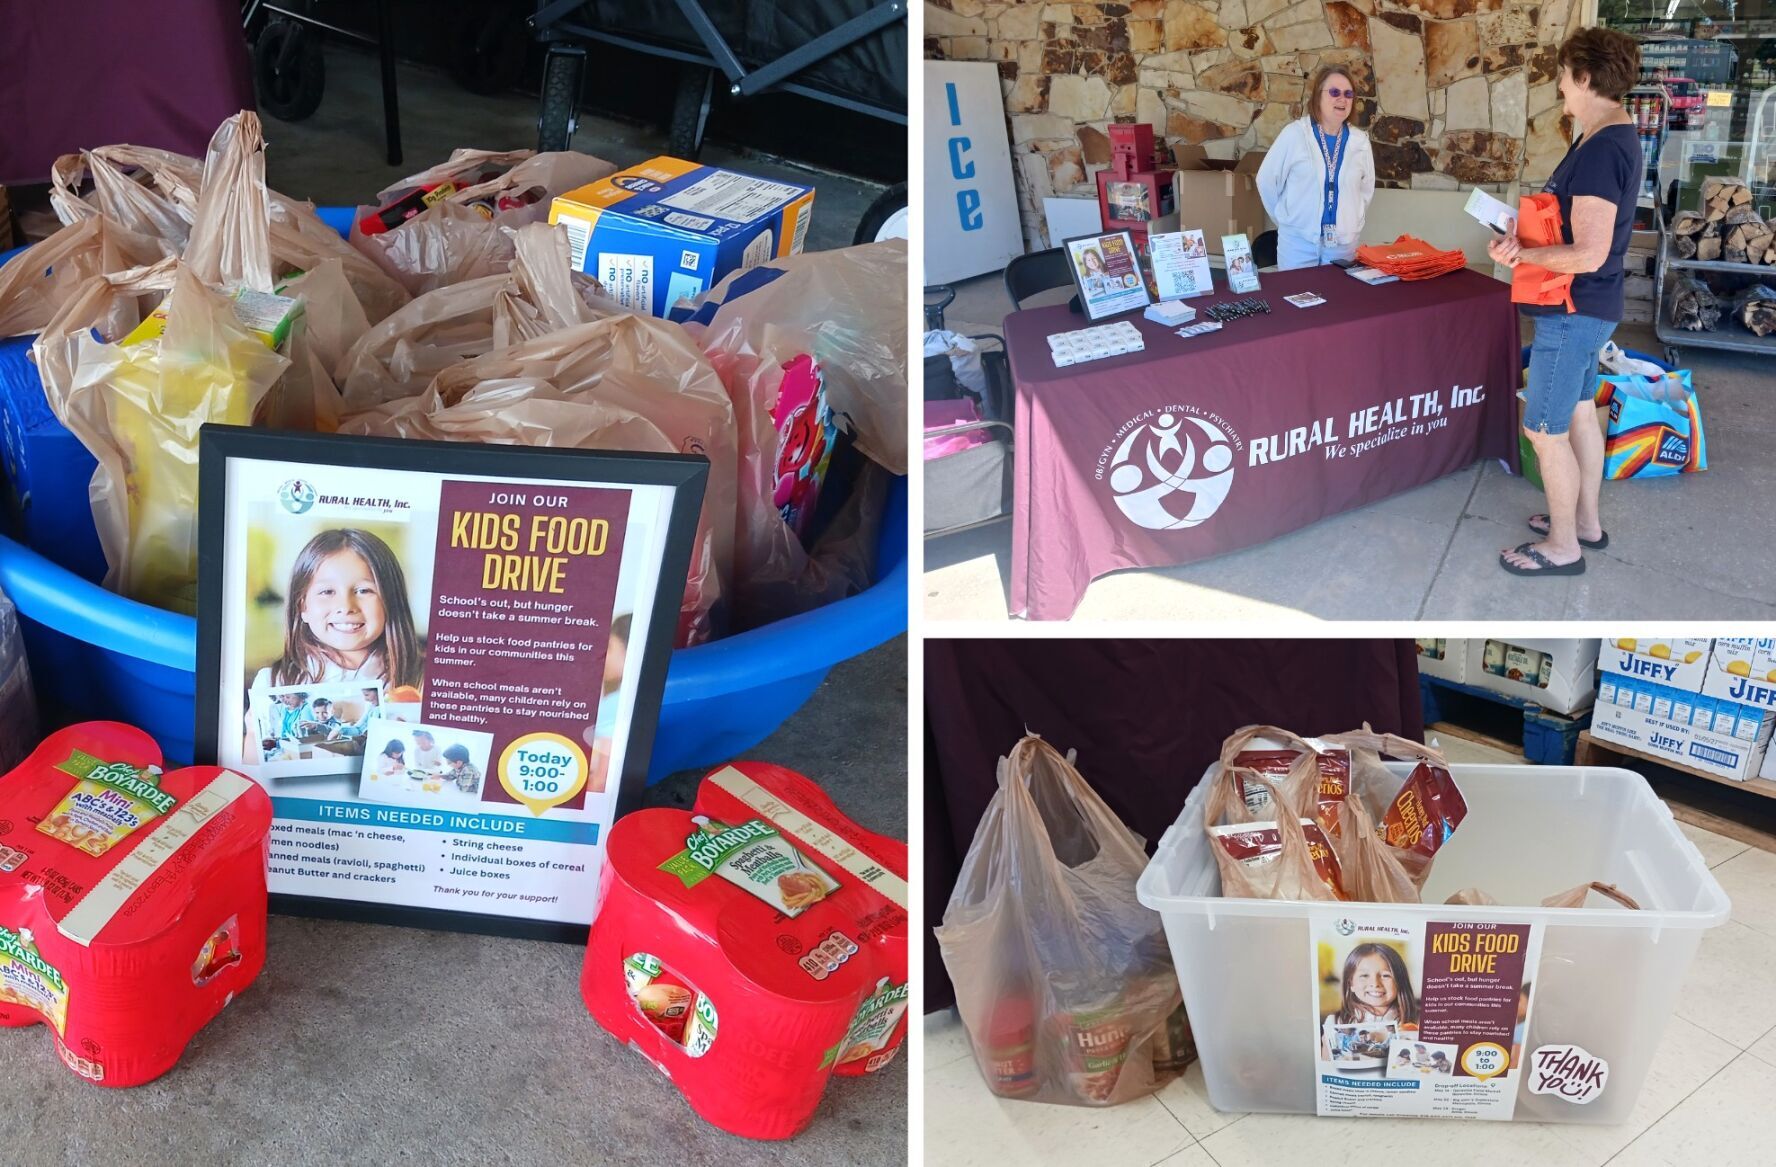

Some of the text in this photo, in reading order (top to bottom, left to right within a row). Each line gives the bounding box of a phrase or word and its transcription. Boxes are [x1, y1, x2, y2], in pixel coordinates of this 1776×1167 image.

[945, 82, 984, 232] Ice
[609, 267, 616, 282] no
[626, 268, 633, 283] no
[641, 270, 649, 284] no
[1248, 384, 1486, 467] RURAL HEALTH, Inc.
[1094, 404, 1244, 480] OB/GYN MEDICAL DENTAL PSYCHIATRY
[1324, 416, 1448, 460] We specialize in you
[1660, 451, 1686, 462] ALDI
[318, 495, 410, 508] RURAL HEALTH, Inc.
[488, 492, 569, 508] JOIN OUR
[450, 511, 609, 556] KIDS FOOD
[482, 554, 569, 594] DRIVE
[439, 595, 573, 613] School's out, but hunger
[438, 609, 479, 619] doesn't
[482, 612, 506, 621] take
[518, 615, 562, 624] summer
[564, 616, 599, 627] break.
[436, 633, 460, 644] Help
[476, 635, 505, 645] stock
[507, 637, 531, 647] food
[533, 639, 575, 650] pantries
[578, 642, 593, 651] for
[434, 645, 574, 662] kids in our communities this
[434, 657, 476, 666] summer.
[432, 678, 562, 696] When school meals aren't
[430, 690, 586, 709] available, many children rely on
[428, 712, 488, 725] and healthy.
[430, 701, 458, 710] these
[460, 703, 500, 714] pantries
[515, 708, 540, 718] stay
[539, 709, 590, 720] nourished
[1645, 718, 1657, 726] BEST
[1666, 723, 1680, 732] USED
[517, 750, 572, 768] Today
[109, 762, 140, 777] Chef
[519, 765, 565, 778] 9:00-
[86, 765, 177, 814] BOYARDEE
[522, 780, 559, 792] 1:00
[75, 802, 92, 812] with
[99, 790, 134, 810] Mini
[71, 793, 106, 809] ABC's
[114, 808, 139, 828] 123's
[319, 805, 526, 833] ITEMS NEEDED INCLUDE
[1396, 790, 1423, 845] Cheerios
[270, 824, 293, 833] oxed
[295, 826, 325, 836] meals
[327, 828, 352, 838] (mac
[367, 832, 406, 843] cheese,
[686, 830, 711, 850] Chef
[271, 839, 340, 852] men noodles)
[452, 839, 524, 852] String cheese
[690, 820, 775, 870] BOYARDEE
[268, 852, 425, 873] anned meals (ravioli, spaghetti)
[451, 852, 585, 872] Individual boxes of cereal
[729, 845, 767, 870] Spaghetti
[740, 852, 783, 876] Meatballs
[268, 866, 396, 884] eanut Butter and crackers
[449, 867, 511, 880] Juice boxes
[433, 886, 558, 904] Thank you for your support!
[1452, 922, 1474, 930] JOIN
[1432, 933, 1519, 953] KIDS FOOD
[0, 940, 66, 989] OYARDEE
[1450, 953, 1498, 974] DRIVE
[1538, 1048, 1604, 1089] THANK
[1326, 1077, 1350, 1087] ITEMS
[1351, 1080, 1382, 1088] NEEDED
